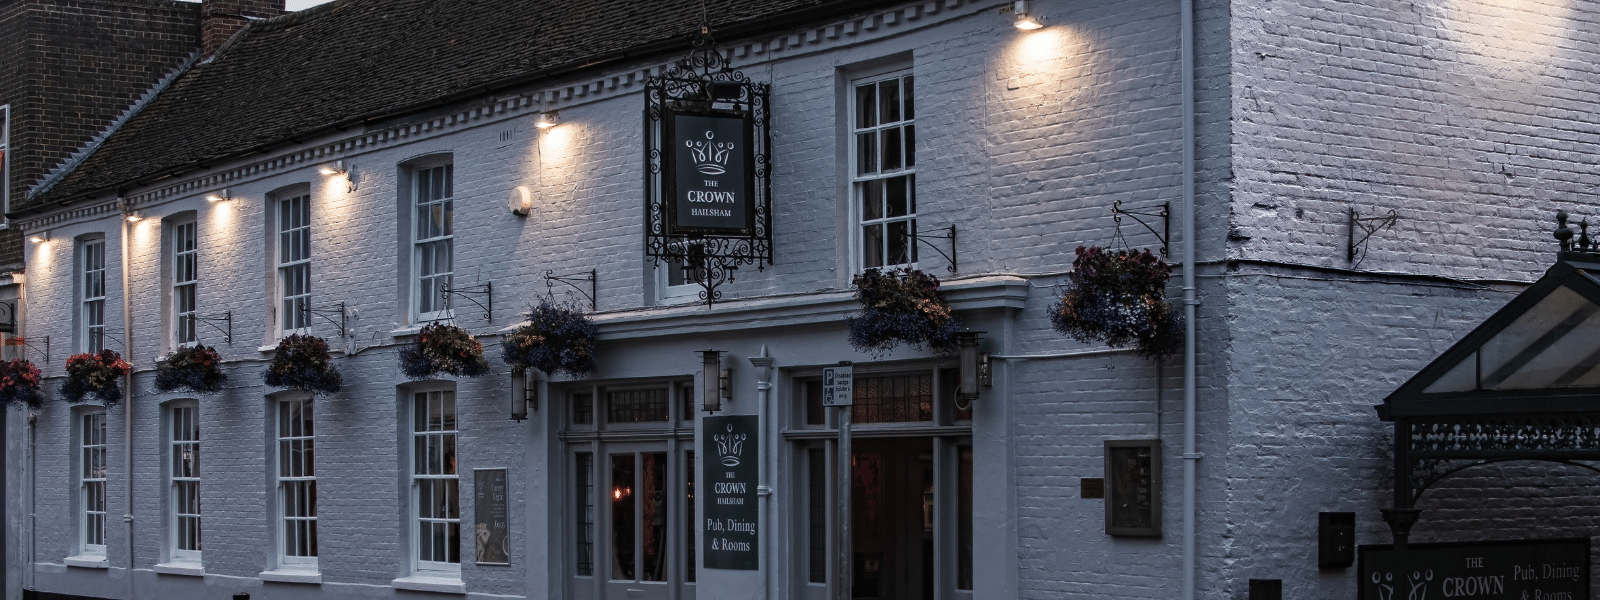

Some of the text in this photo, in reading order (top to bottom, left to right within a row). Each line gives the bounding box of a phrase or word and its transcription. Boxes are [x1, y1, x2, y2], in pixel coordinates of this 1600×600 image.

[687, 190, 735, 203] CROWN
[691, 208, 731, 217] HAILSHAM
[826, 371, 833, 384] P
[714, 482, 746, 494] CROWN
[707, 518, 756, 535] Pub, Dining
[711, 537, 750, 551] & Rooms
[1465, 557, 1484, 568] THE
[1514, 563, 1580, 581] Pub, Dining
[1442, 575, 1505, 598] CROWN
